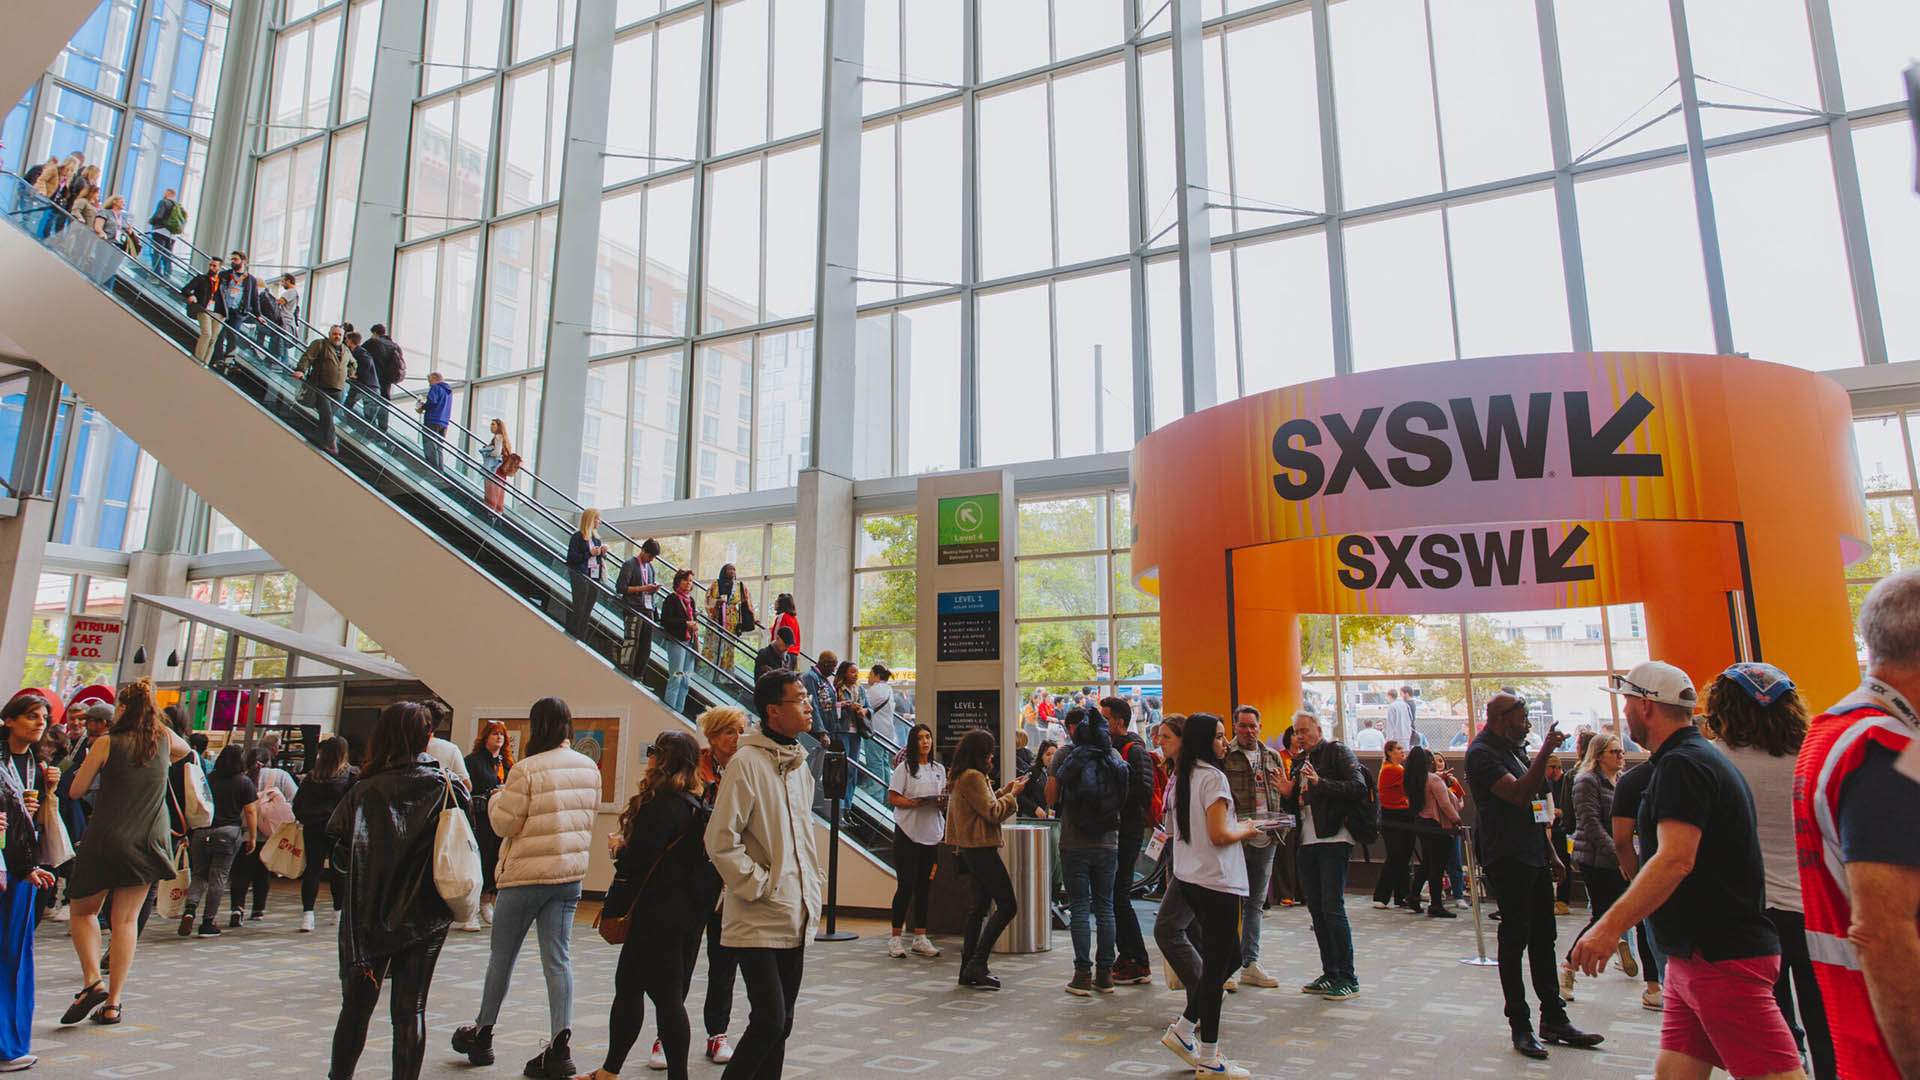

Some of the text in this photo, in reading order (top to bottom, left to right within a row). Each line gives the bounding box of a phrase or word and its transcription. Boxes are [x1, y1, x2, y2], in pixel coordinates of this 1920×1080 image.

[1272, 391, 1553, 501] SXSW
[1336, 530, 1525, 590] SXSW
[954, 595, 976, 603] LEVEL
[74, 621, 119, 634] ATRIUM
[71, 633, 103, 645] CAFE
[70, 646, 101, 658] & CO.
